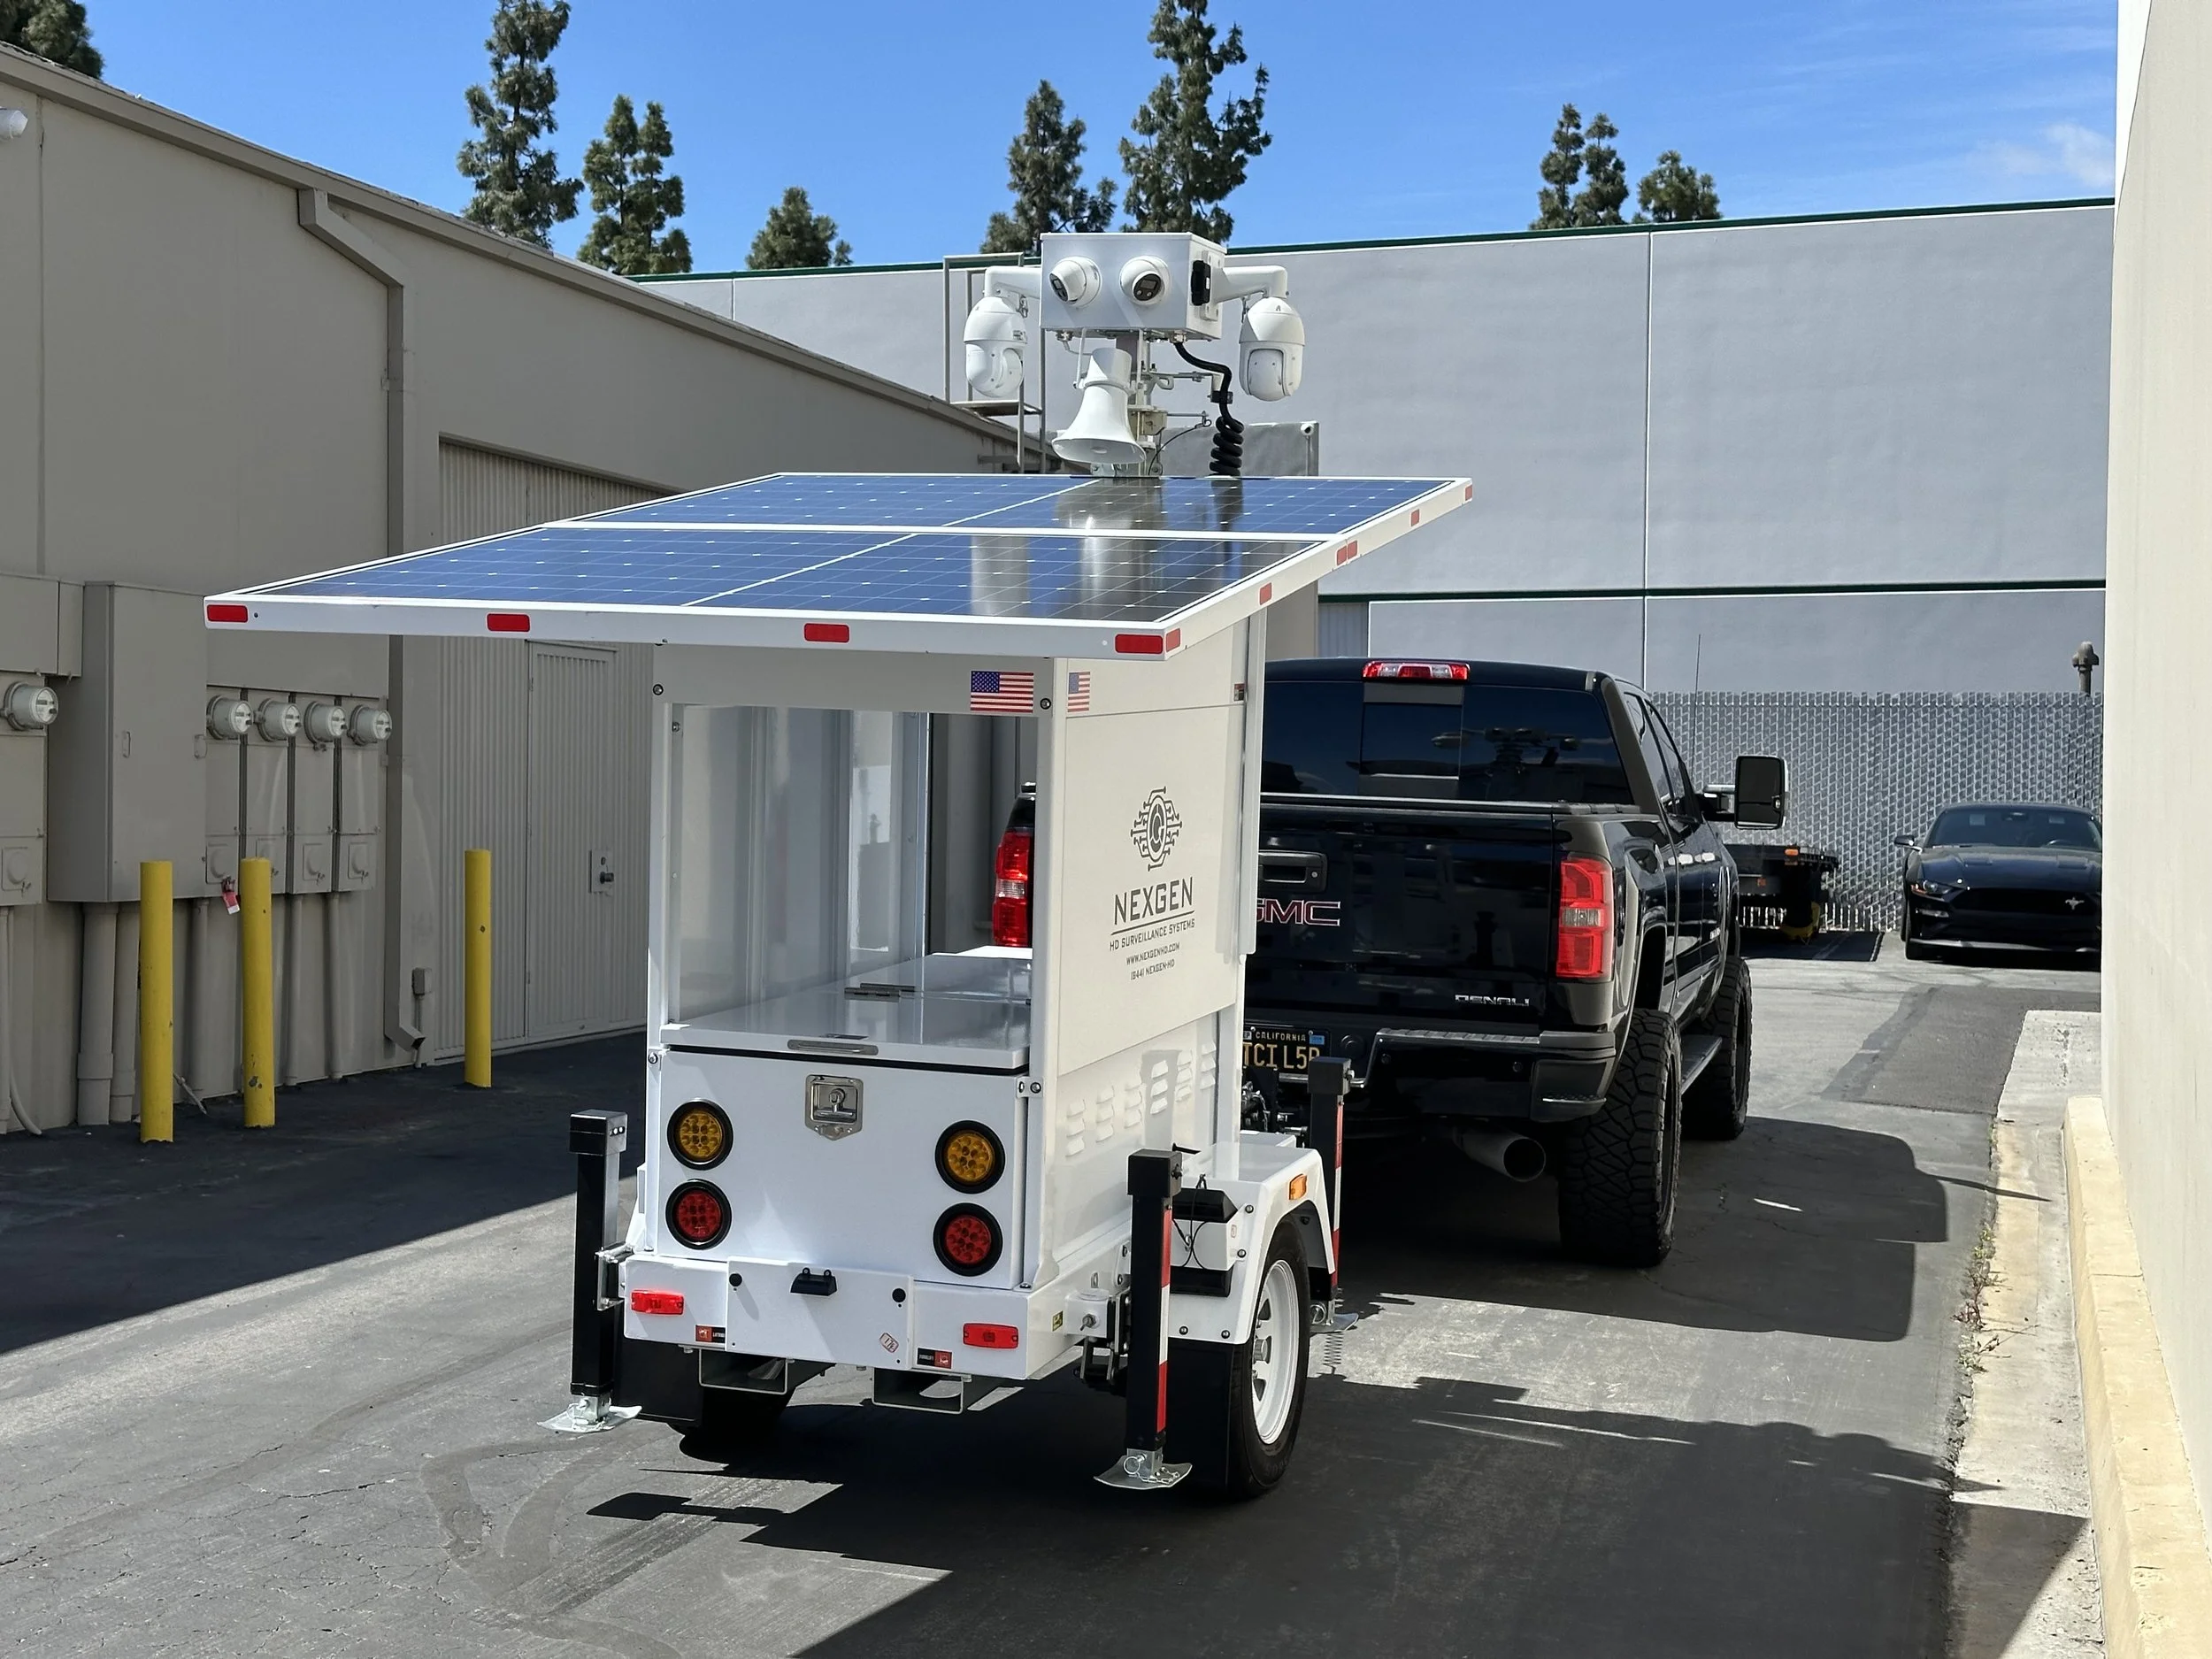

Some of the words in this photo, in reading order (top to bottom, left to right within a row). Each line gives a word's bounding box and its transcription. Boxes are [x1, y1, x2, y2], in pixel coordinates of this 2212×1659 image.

[1114, 877, 1193, 926] NEXGEN
[1256, 898, 1340, 926] MC
[1110, 940, 1119, 951] HD
[1121, 926, 1167, 949] SURVEILLANCE
[1169, 918, 1195, 934] SYSTEMS
[1126, 941, 1180, 965] WWW.NEXGENHD.COM
[1455, 994, 1530, 1007] DENALI
[1256, 1032, 1306, 1041] CALIFORNIA
